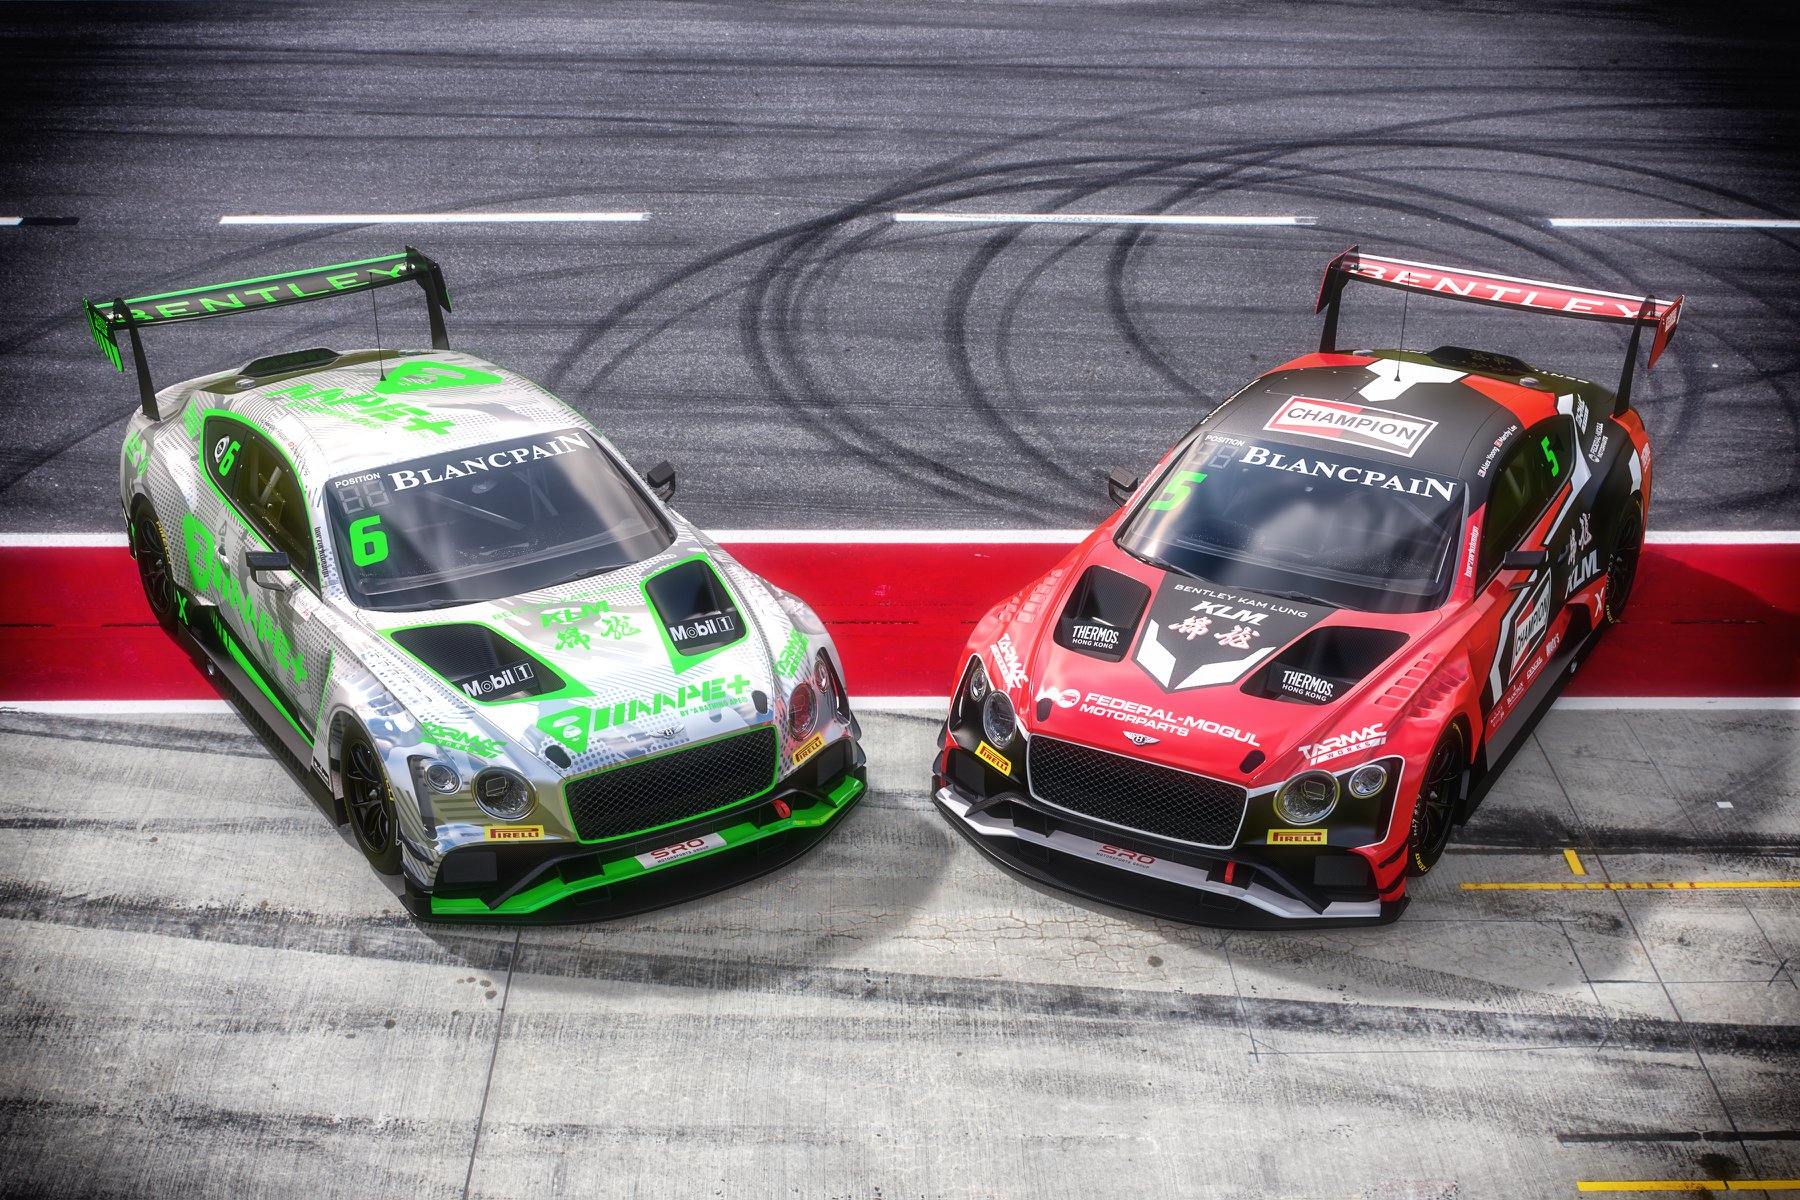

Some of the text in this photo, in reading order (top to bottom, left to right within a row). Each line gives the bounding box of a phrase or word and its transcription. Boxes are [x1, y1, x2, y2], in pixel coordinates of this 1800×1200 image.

[116, 263, 407, 322] BENTLEY
[1349, 262, 1662, 319] BENTLEY
[1287, 406, 1418, 441] CHAMPION
[1204, 434, 1246, 447] POSITION
[218, 440, 241, 477] 6
[387, 433, 590, 492] BLANCPAIN
[1540, 436, 1560, 477] 5
[334, 472, 381, 489] POSITION
[1238, 445, 1457, 502] BLANCPAIN
[1147, 470, 1208, 512] 5
[349, 514, 389, 567] 6
[1564, 549, 1601, 600] KLM
[541, 600, 610, 627] KLM
[1174, 584, 1309, 618] BENTLEY KAM LUNG
[1190, 600, 1269, 626] KLM
[669, 619, 718, 642] Mobil
[1072, 625, 1118, 645] THERMOS
[1072, 638, 1114, 650] HONG KONG
[462, 669, 516, 699] Mobil
[1282, 670, 1334, 697] THERMOS
[1282, 683, 1327, 702] HONG KONG
[680, 709, 690, 718] BY
[699, 700, 729, 713] BATHING
[1078, 703, 1190, 737] MOTORPARTS
[1084, 692, 1262, 748] FEDERAL-MOGUL
[795, 735, 823, 763] PIRELLI
[1298, 722, 1388, 760] TARMAC
[1326, 741, 1372, 759] WORKS
[979, 745, 1010, 773] PIRELLI
[489, 827, 540, 839] PIRELLI
[1272, 831, 1323, 843] PIRELLI
[650, 837, 705, 859] SRO
[657, 845, 709, 863] MOTORSPORTS GROUP
[1095, 852, 1131, 864] MOTORSPORTS
[1099, 843, 1157, 865] SRO
